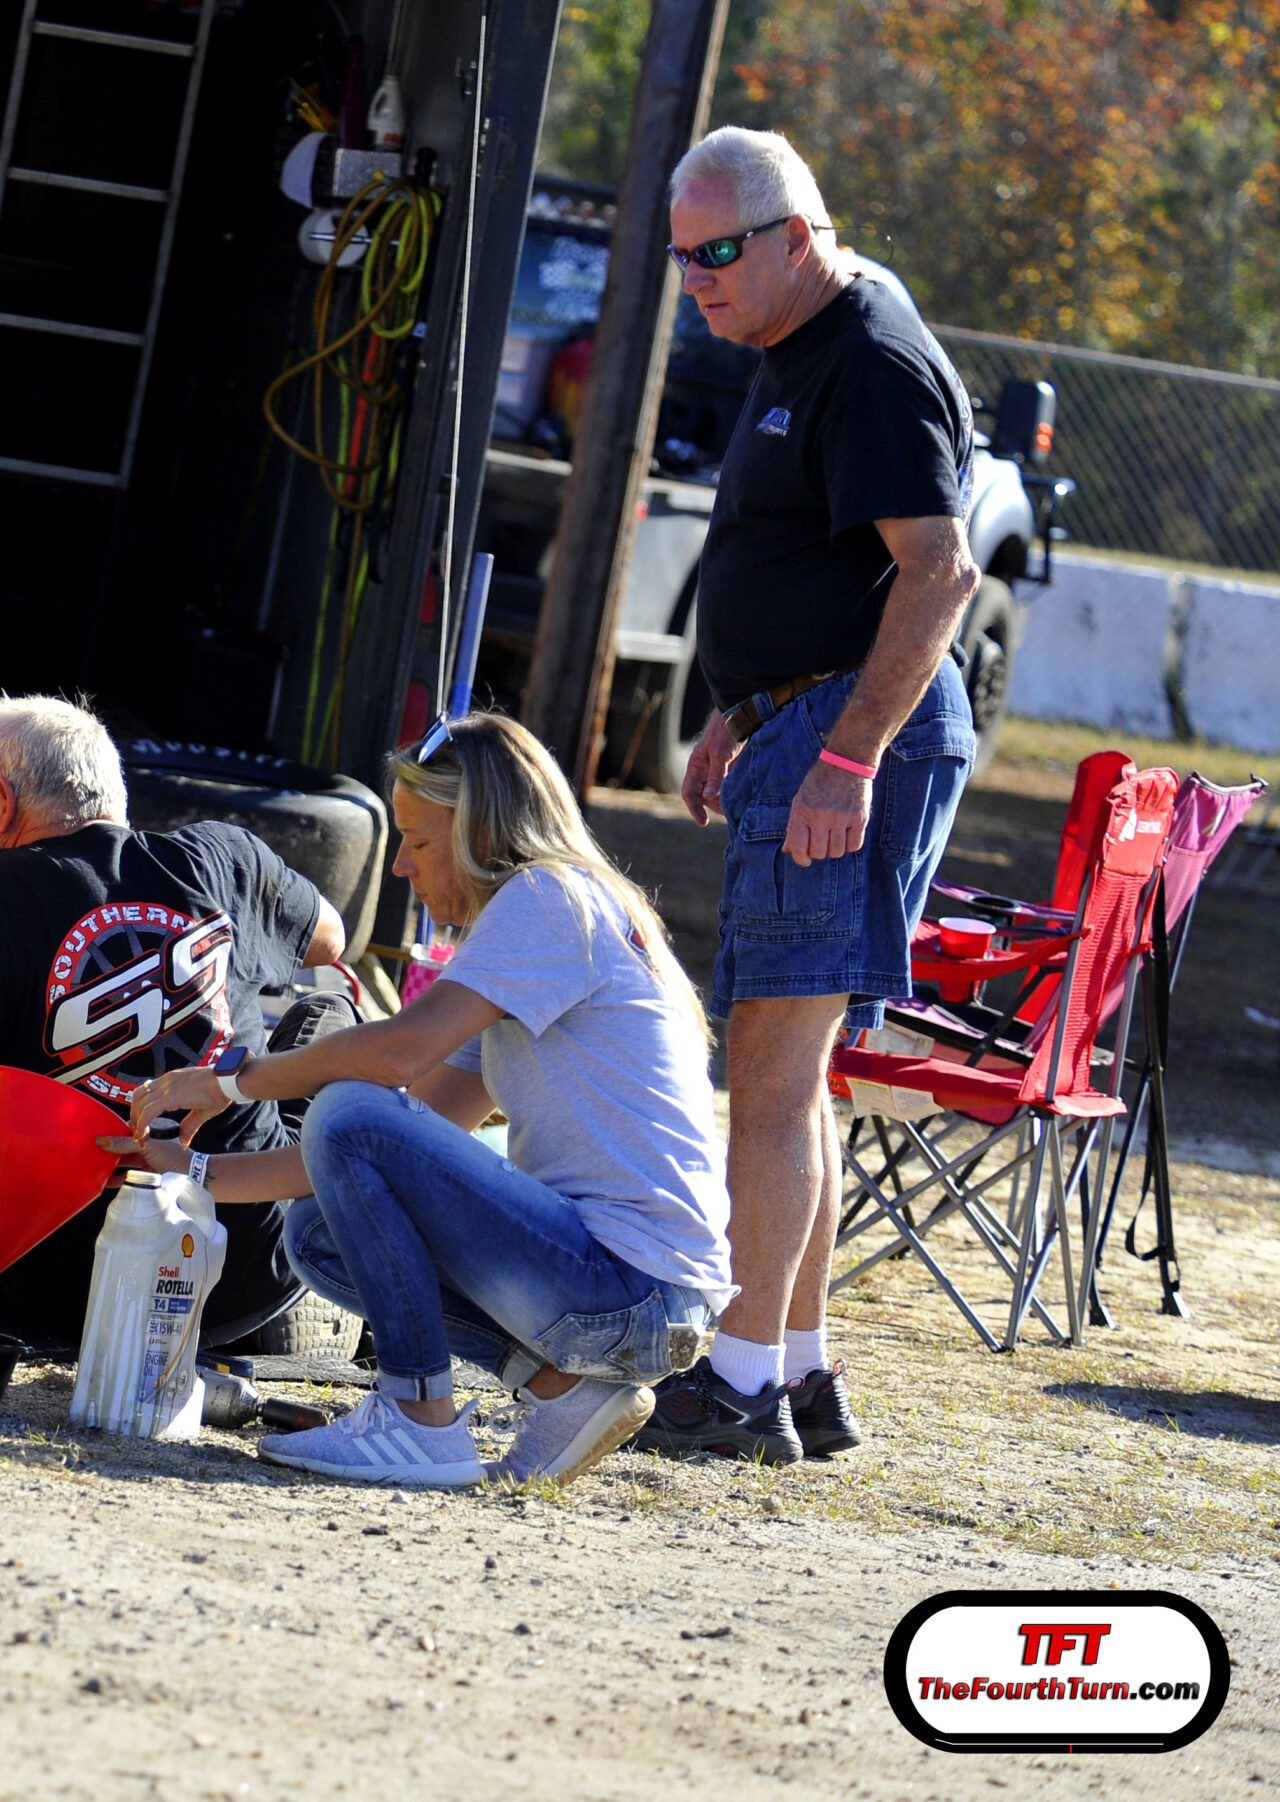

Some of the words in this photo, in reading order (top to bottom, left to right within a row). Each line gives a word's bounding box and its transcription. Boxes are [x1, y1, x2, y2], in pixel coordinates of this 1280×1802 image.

[49, 906, 195, 1005] SOUTHERN
[158, 1266, 180, 1278] Shell
[155, 1280, 194, 1296] ROTELLA
[154, 1299, 167, 1310] T4
[145, 1353, 169, 1366] ENGINE
[143, 1365, 154, 1377] OIL
